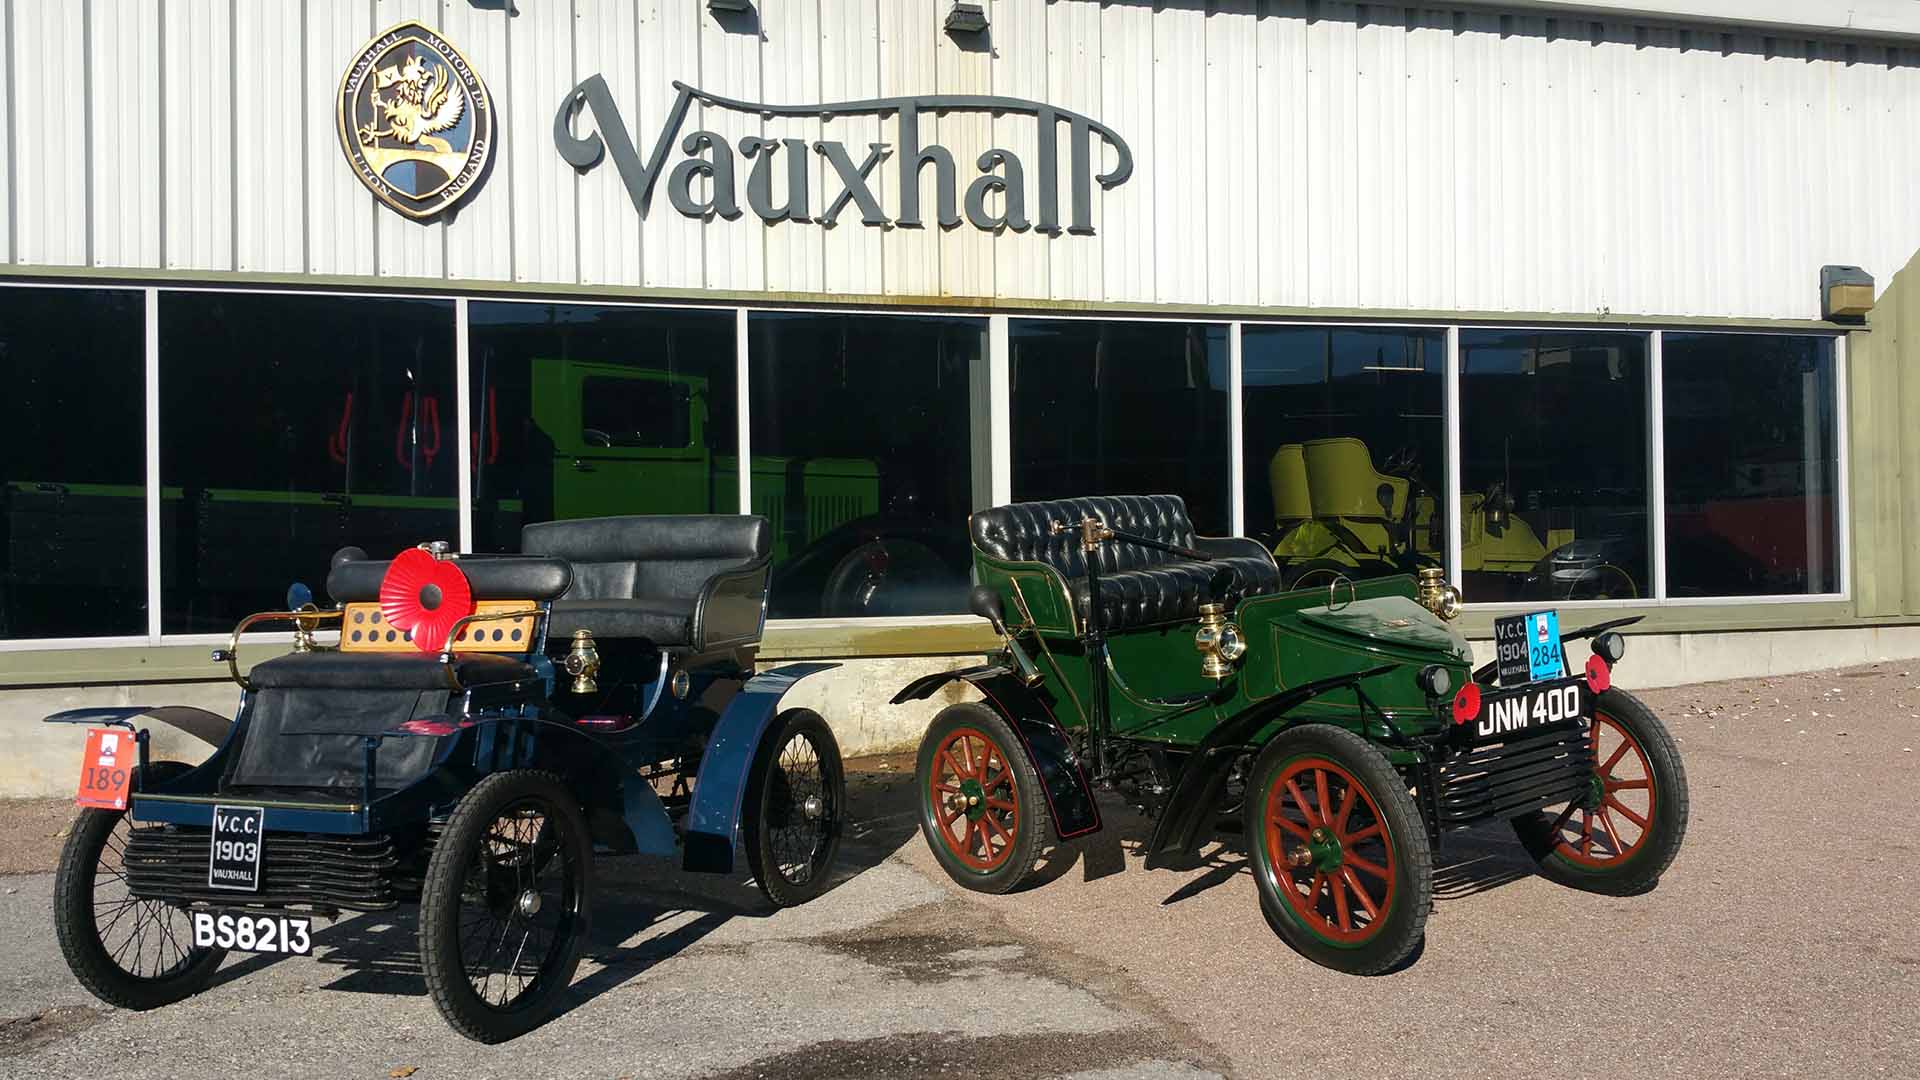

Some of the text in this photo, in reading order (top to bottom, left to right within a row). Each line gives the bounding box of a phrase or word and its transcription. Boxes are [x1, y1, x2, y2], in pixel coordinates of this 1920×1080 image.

[345, 32, 402, 94] VAUXHALL
[427, 34, 475, 87] MOTORS
[553, 73, 1133, 237] Vauxhall
[441, 139, 486, 201] ENGLAND
[1496, 622, 1527, 640] V.C.C.
[1498, 641, 1528, 662] 1904
[1532, 643, 1560, 667] 284
[1501, 664, 1529, 675] VAUXHALL
[1479, 685, 1580, 736] JNM 400
[86, 767, 126, 791] 189
[217, 815, 258, 834] V.C.C.
[215, 840, 257, 862] 1903
[213, 868, 253, 881] VAUXHALL
[195, 913, 311, 954] BS8213
